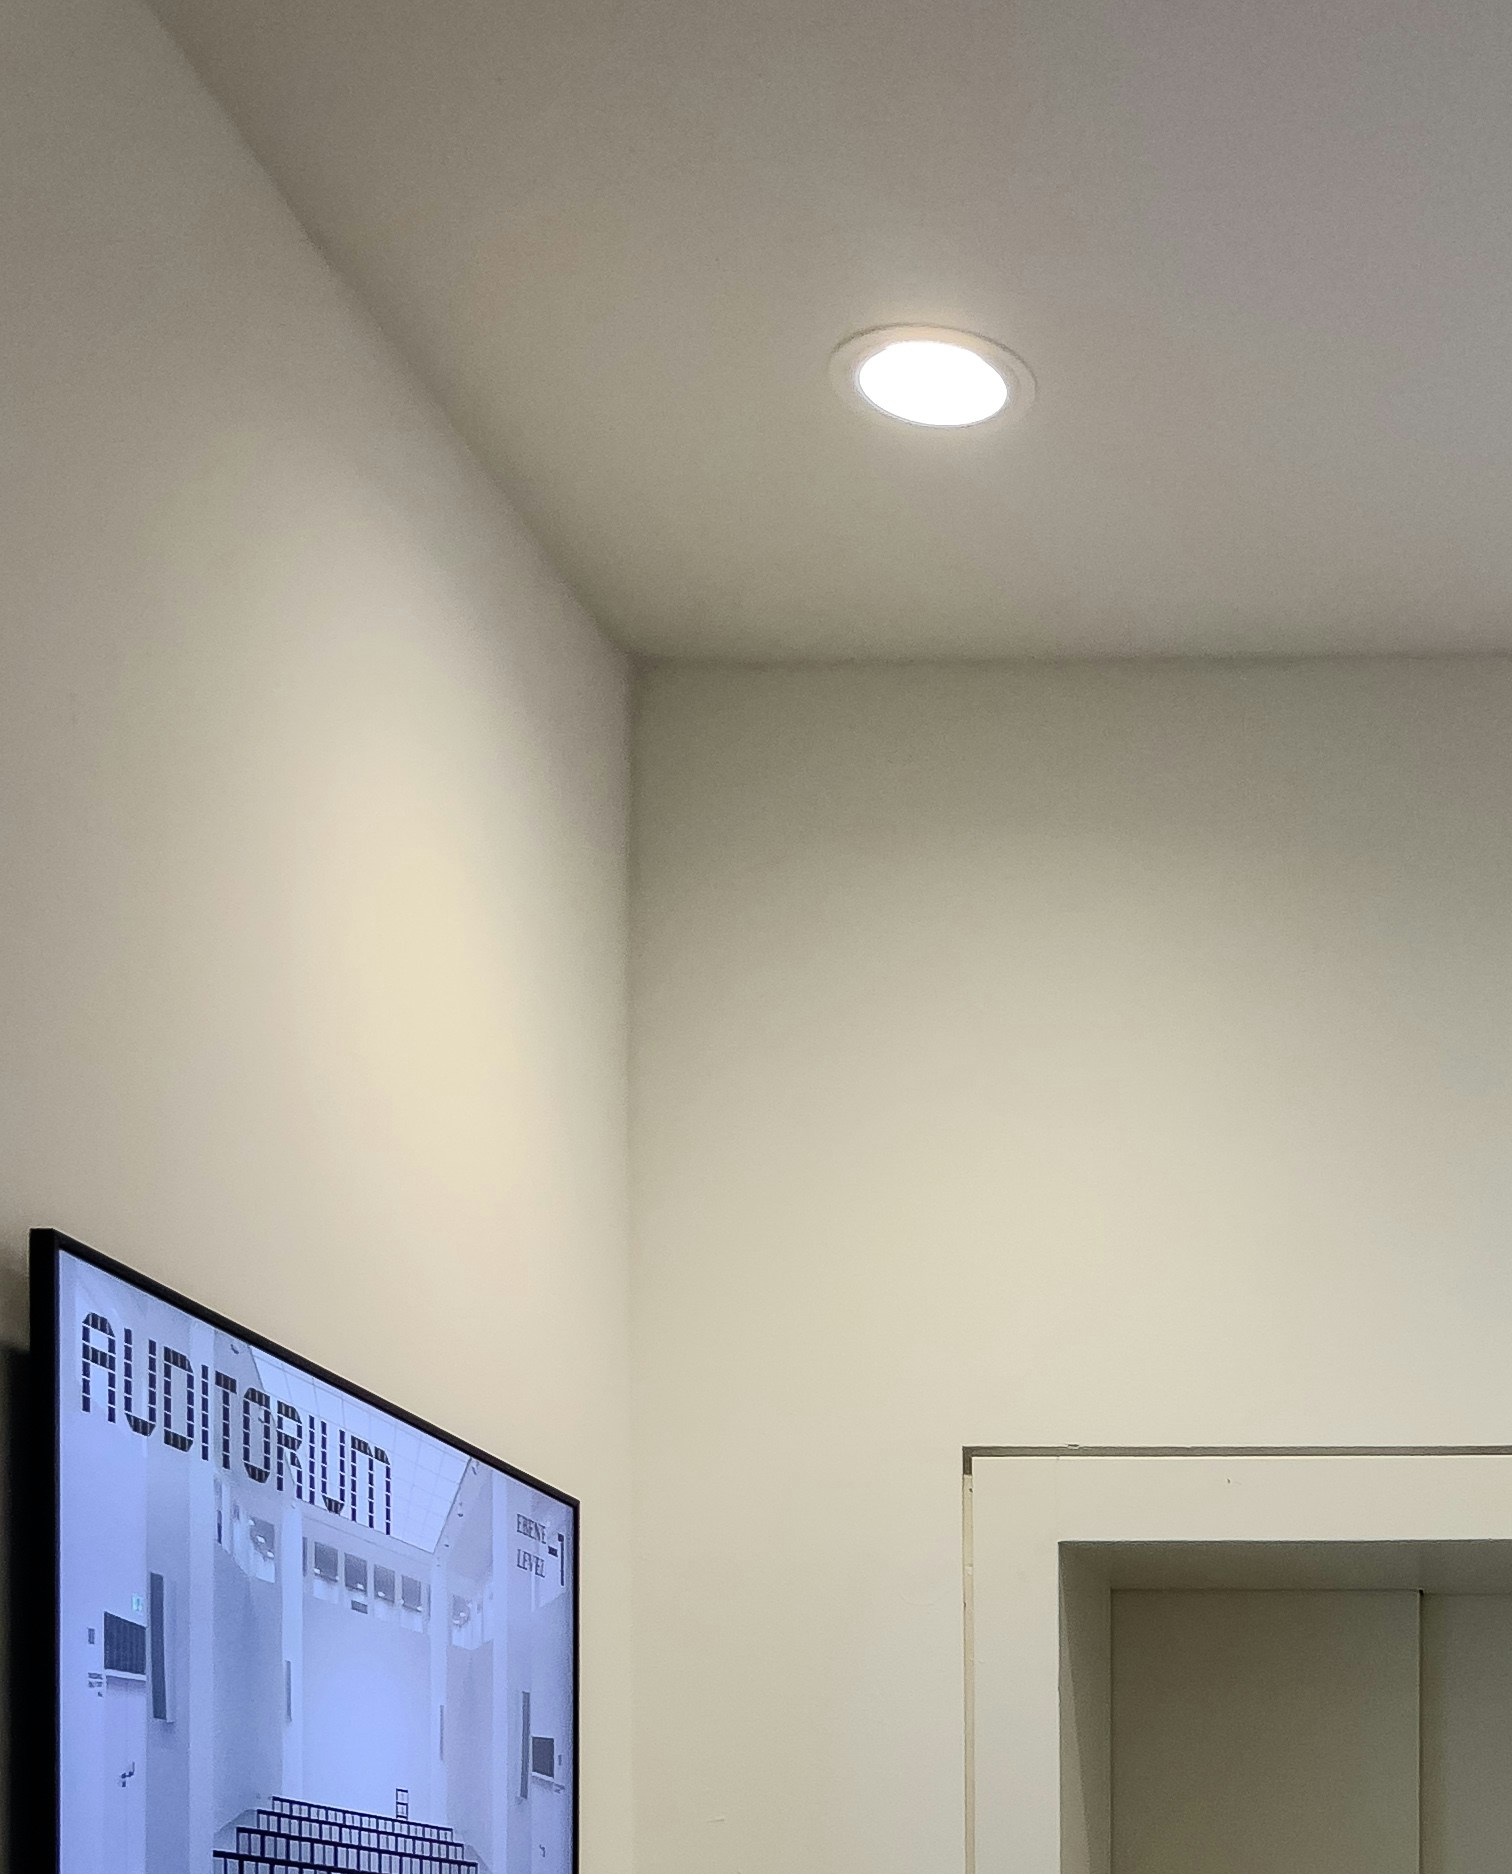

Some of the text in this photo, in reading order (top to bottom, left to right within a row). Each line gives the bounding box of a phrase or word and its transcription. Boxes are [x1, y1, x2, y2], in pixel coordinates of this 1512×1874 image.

[82, 1312, 390, 1535] AUDITORIUM
[517, 1513, 546, 1544] EBENE
[517, 1549, 545, 1578] LEVEL
